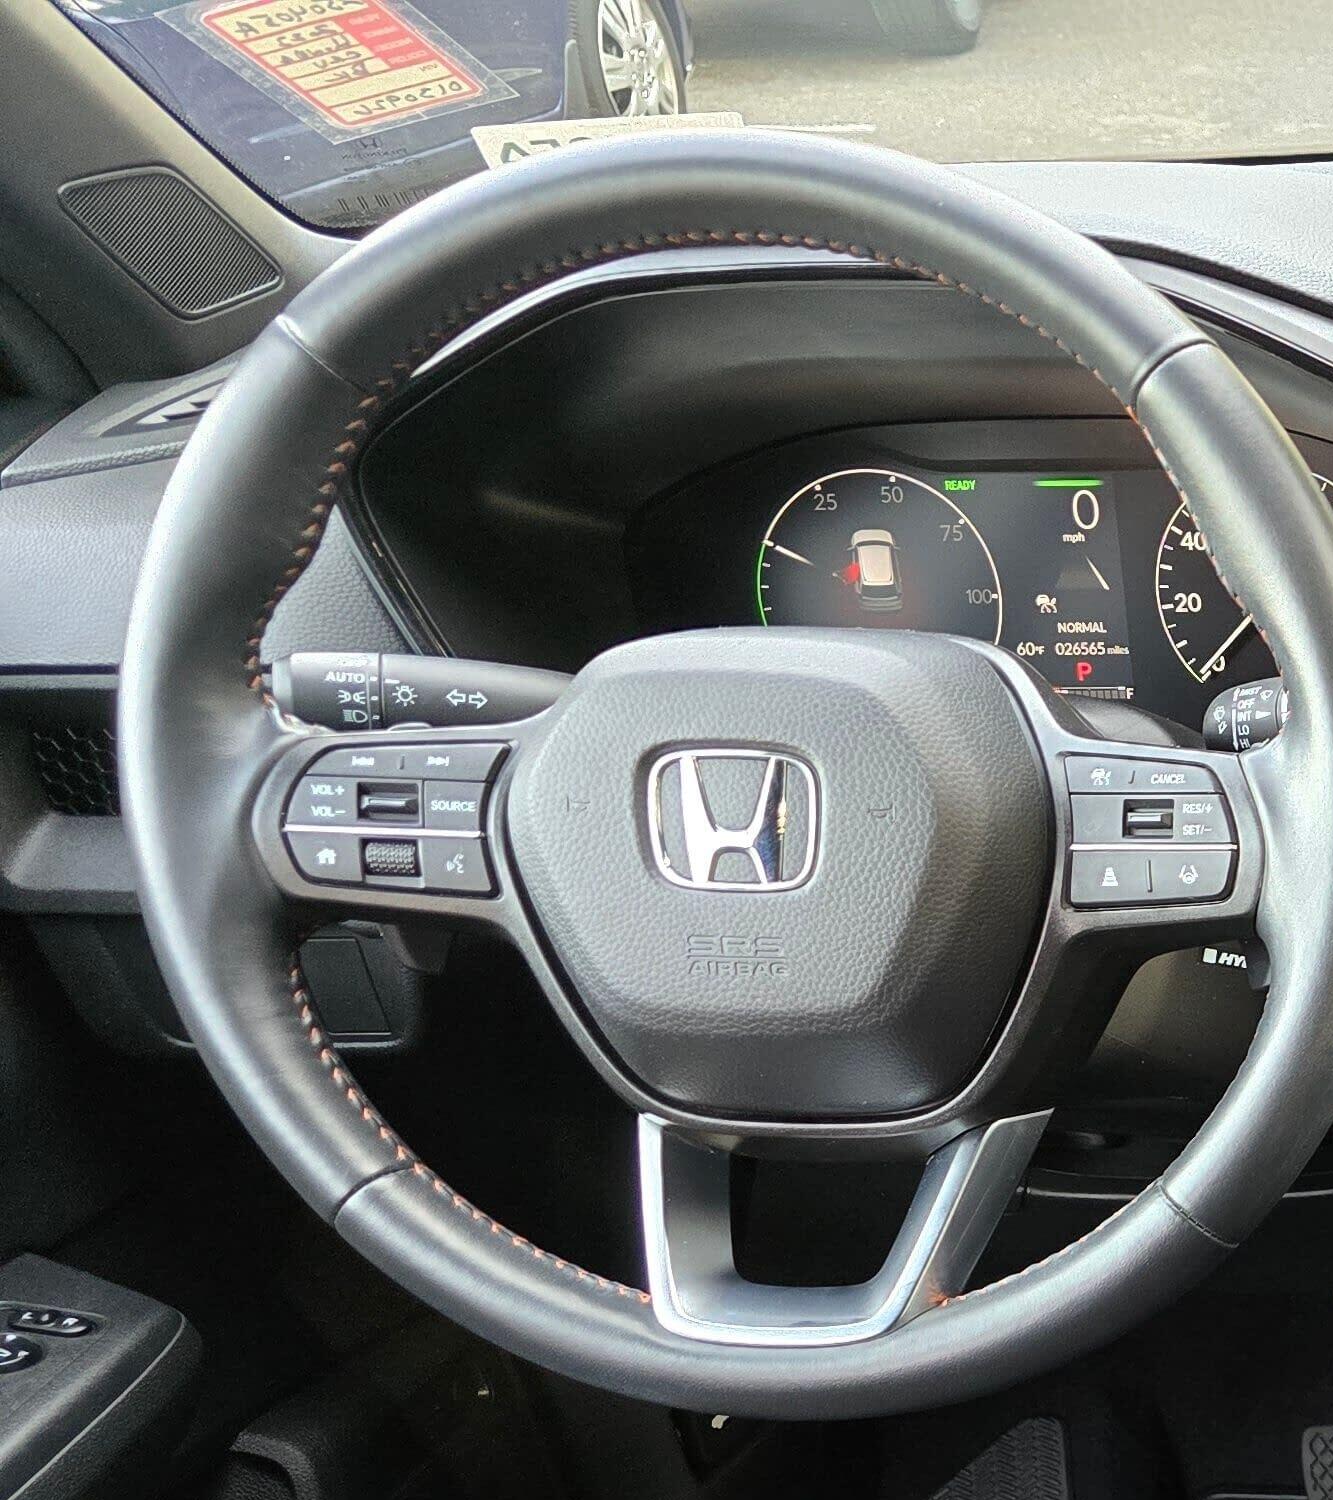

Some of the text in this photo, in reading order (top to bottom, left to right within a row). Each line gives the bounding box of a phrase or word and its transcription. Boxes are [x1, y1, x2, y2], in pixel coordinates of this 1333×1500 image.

[944, 479, 976, 491] READY
[880, 486, 904, 504] 50
[813, 493, 838, 512] 25
[1072, 489, 1099, 530] 0
[939, 524, 964, 542] 75
[1062, 531, 1086, 543] mph
[1180, 530, 1206, 551] 40
[965, 589, 992, 605] 100
[1174, 593, 1202, 613] 20
[1056, 621, 1107, 633] NORMAL
[1055, 641, 1130, 656] 026565 miles
[324, 671, 366, 684] AUTO
[1076, 662, 1092, 682] P
[1126, 687, 1135, 700] F
[1239, 686, 1263, 697] MIST
[1237, 698, 1256, 710] OFF
[1237, 711, 1252, 722] INT
[1238, 724, 1250, 736] LO
[1150, 773, 1186, 785] CANCEL
[310, 785, 345, 796] VOL+
[430, 800, 476, 813] SOURCE
[1182, 803, 1213, 815] RES/+
[686, 934, 784, 954] SRS
[687, 960, 789, 977] AIRBAG
